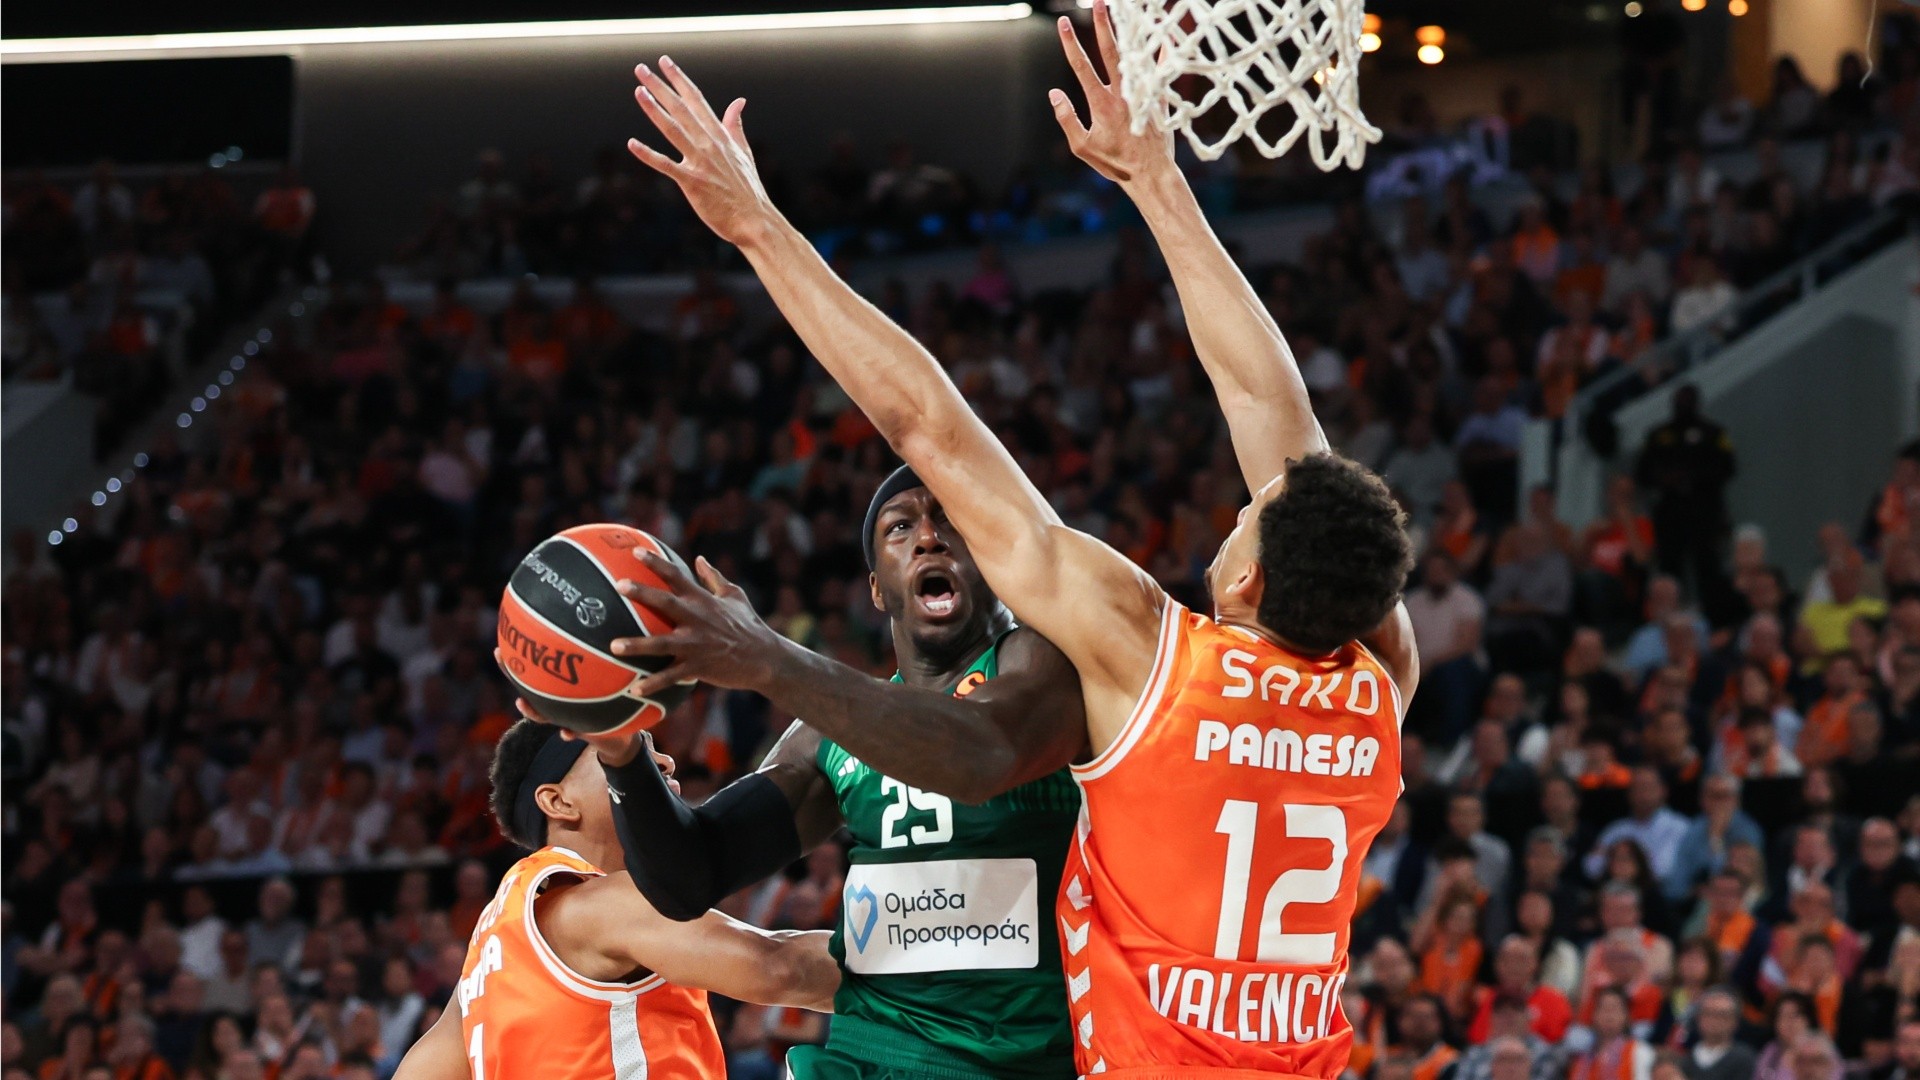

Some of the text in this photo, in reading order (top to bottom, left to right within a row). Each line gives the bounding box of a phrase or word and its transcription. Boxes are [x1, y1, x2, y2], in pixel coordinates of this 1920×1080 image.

[1220, 648, 1379, 716] SAKO
[1194, 720, 1380, 777] PAMESA
[880, 775, 953, 849] 25
[884, 888, 966, 919] Ομάδα
[1214, 799, 1349, 965] 12
[888, 917, 1030, 947] Προσφοράς
